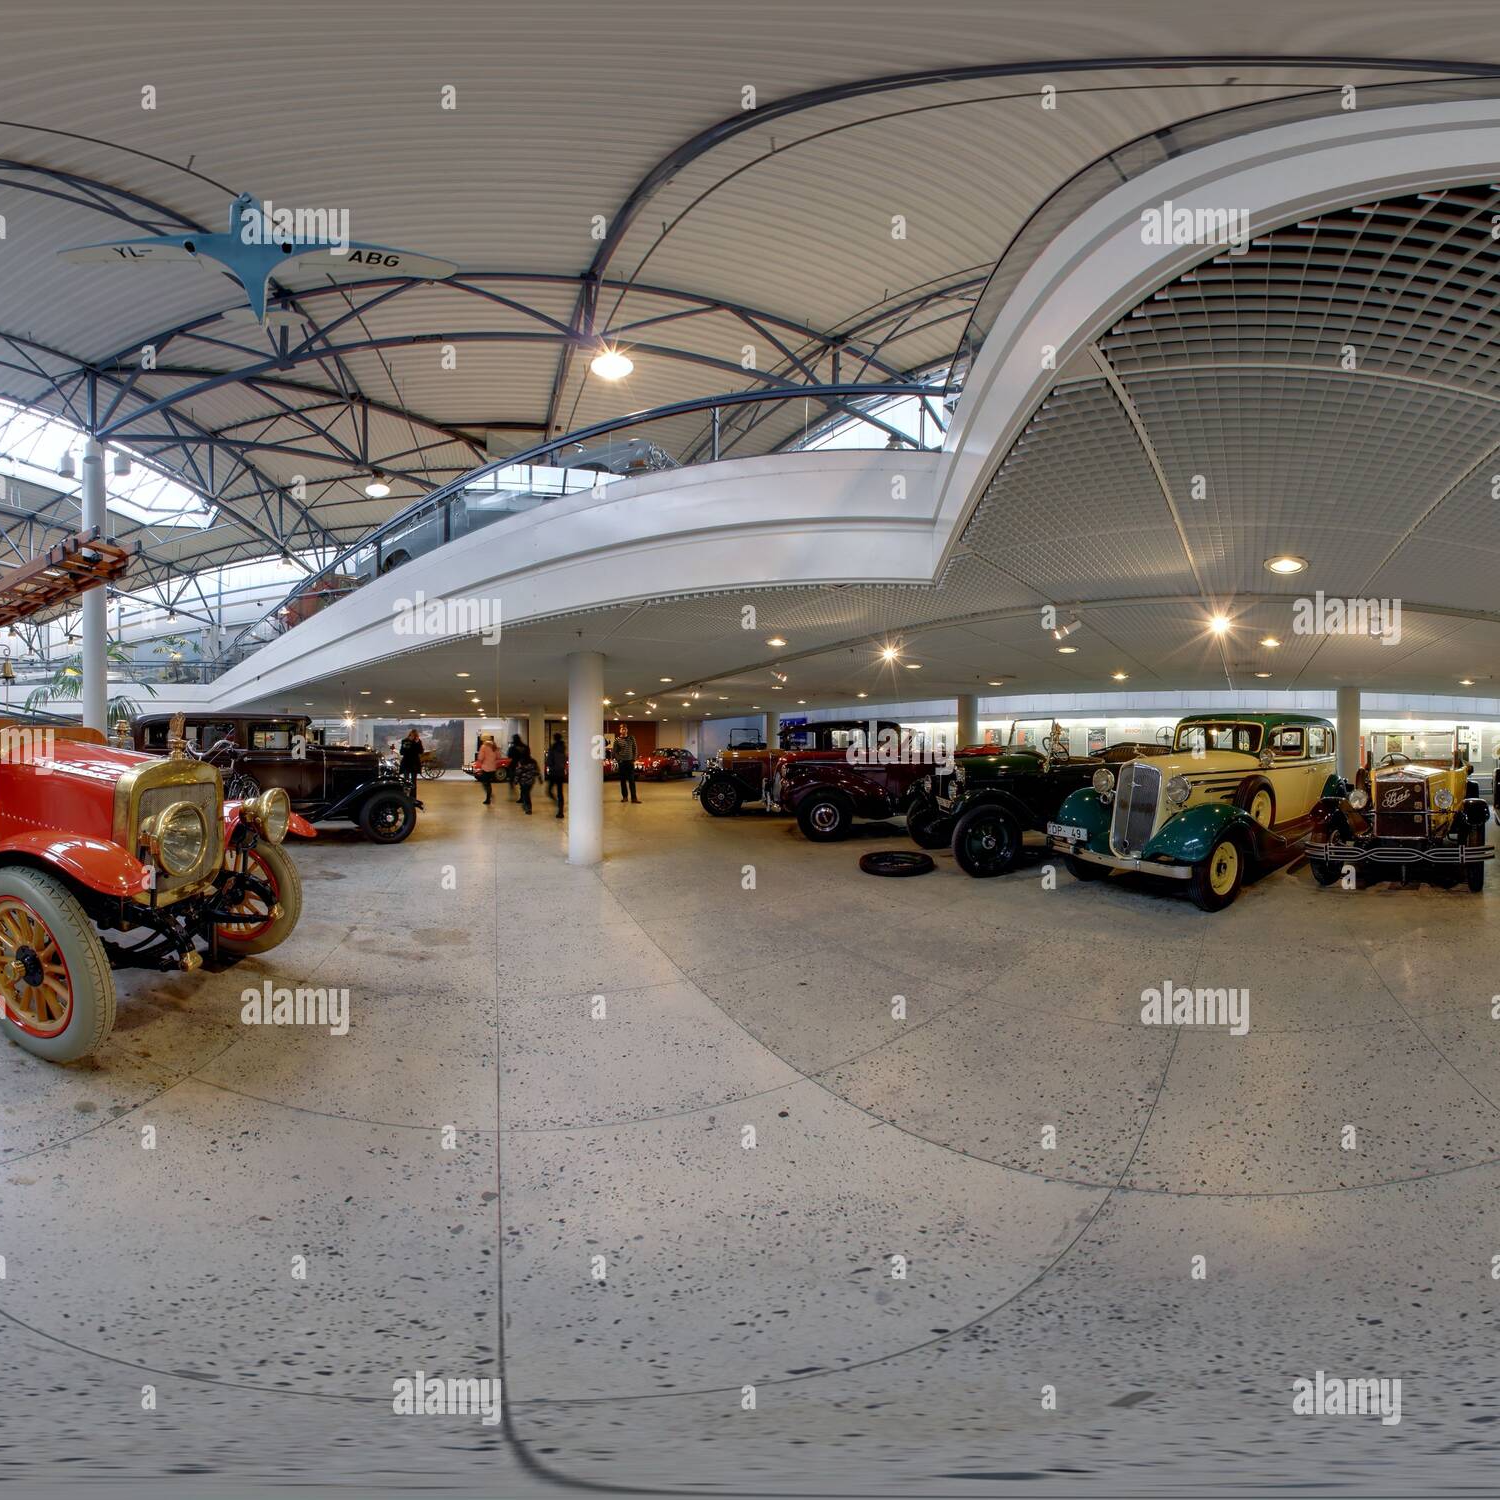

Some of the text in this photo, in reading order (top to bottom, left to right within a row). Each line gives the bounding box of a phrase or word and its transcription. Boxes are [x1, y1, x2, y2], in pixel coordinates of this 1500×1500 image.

[348, 250, 400, 268] ABG
[1381, 785, 1411, 808] Fiat
[1071, 828, 1082, 839] 49
